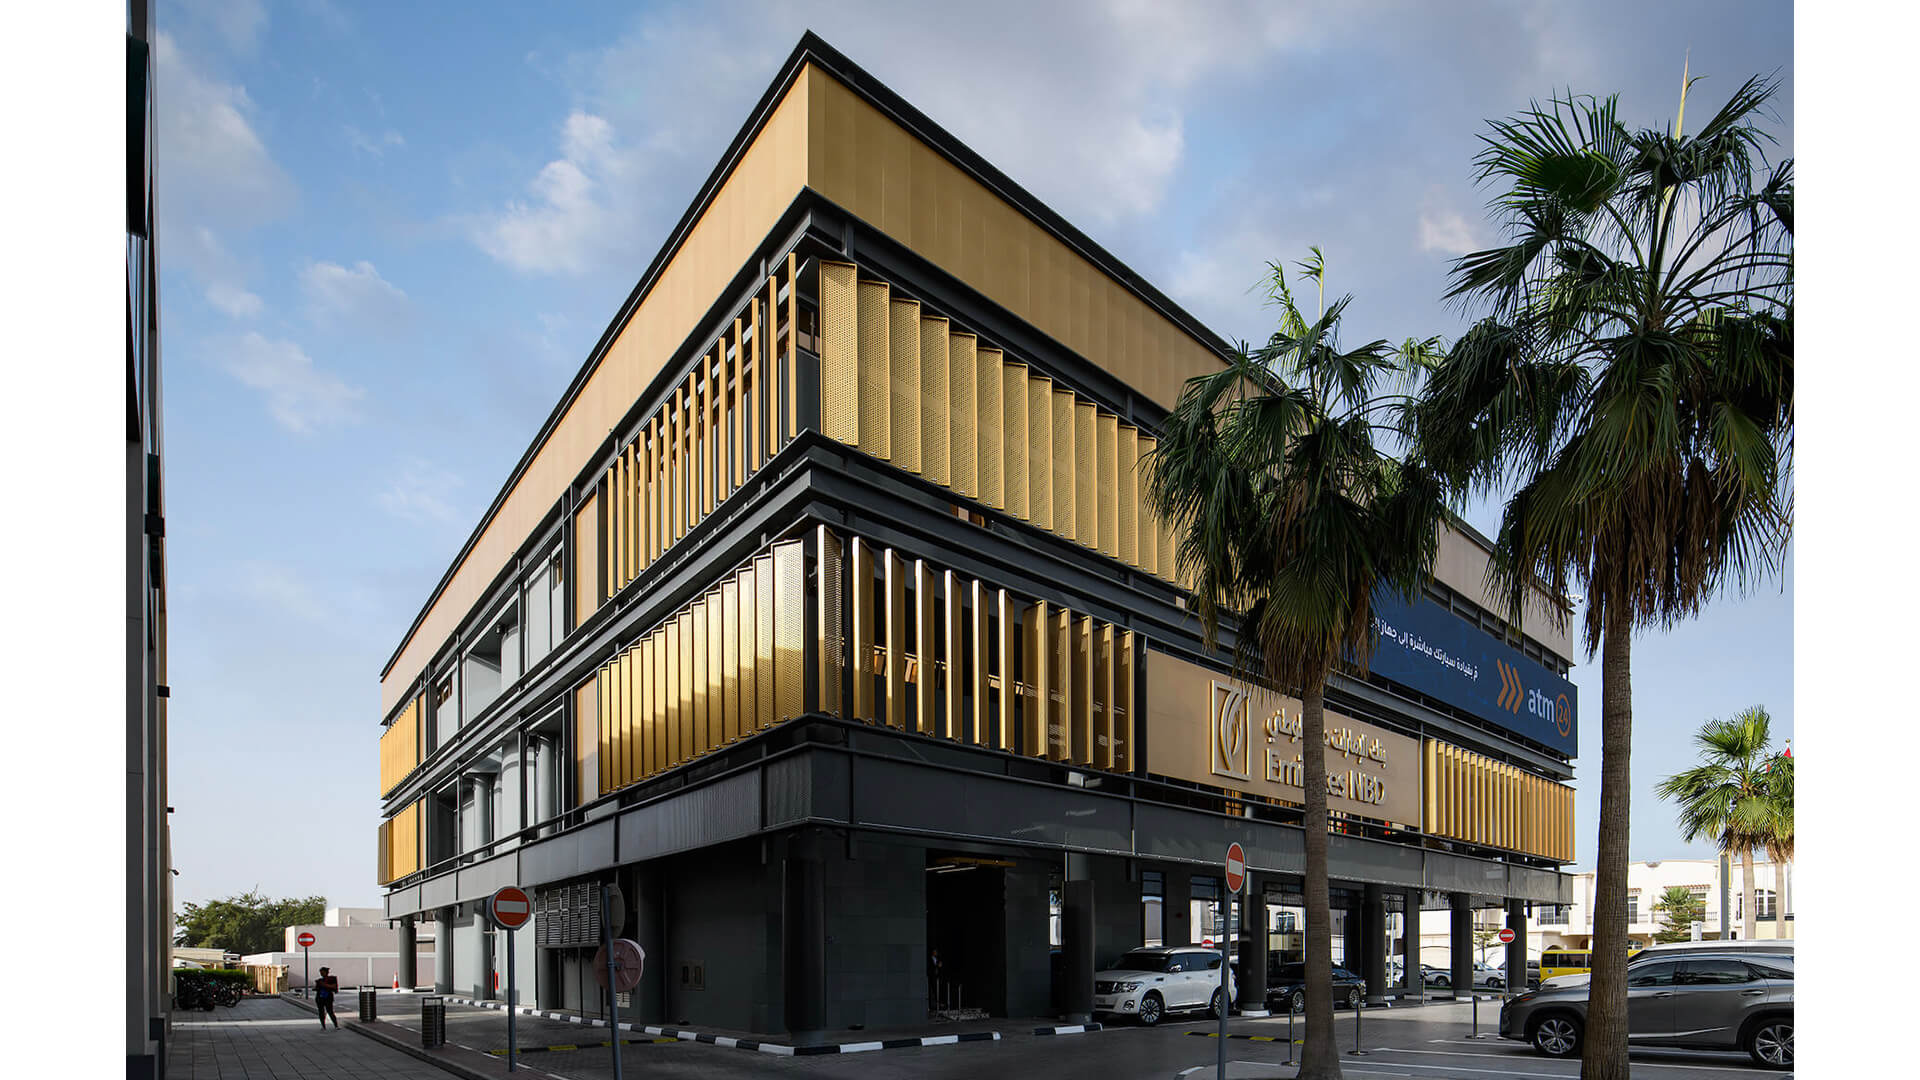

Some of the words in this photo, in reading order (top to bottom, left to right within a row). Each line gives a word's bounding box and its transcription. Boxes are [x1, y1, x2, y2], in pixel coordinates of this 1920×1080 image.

[1380, 619, 1398, 642] جهاز
[1398, 631, 1409, 649] إلى
[1409, 633, 1433, 657] مباشرة
[1433, 647, 1456, 668] سيارتك
[1528, 688, 1555, 723] atm
[1368, 738, 1387, 769] بنك
[1347, 769, 1386, 806] NBD
